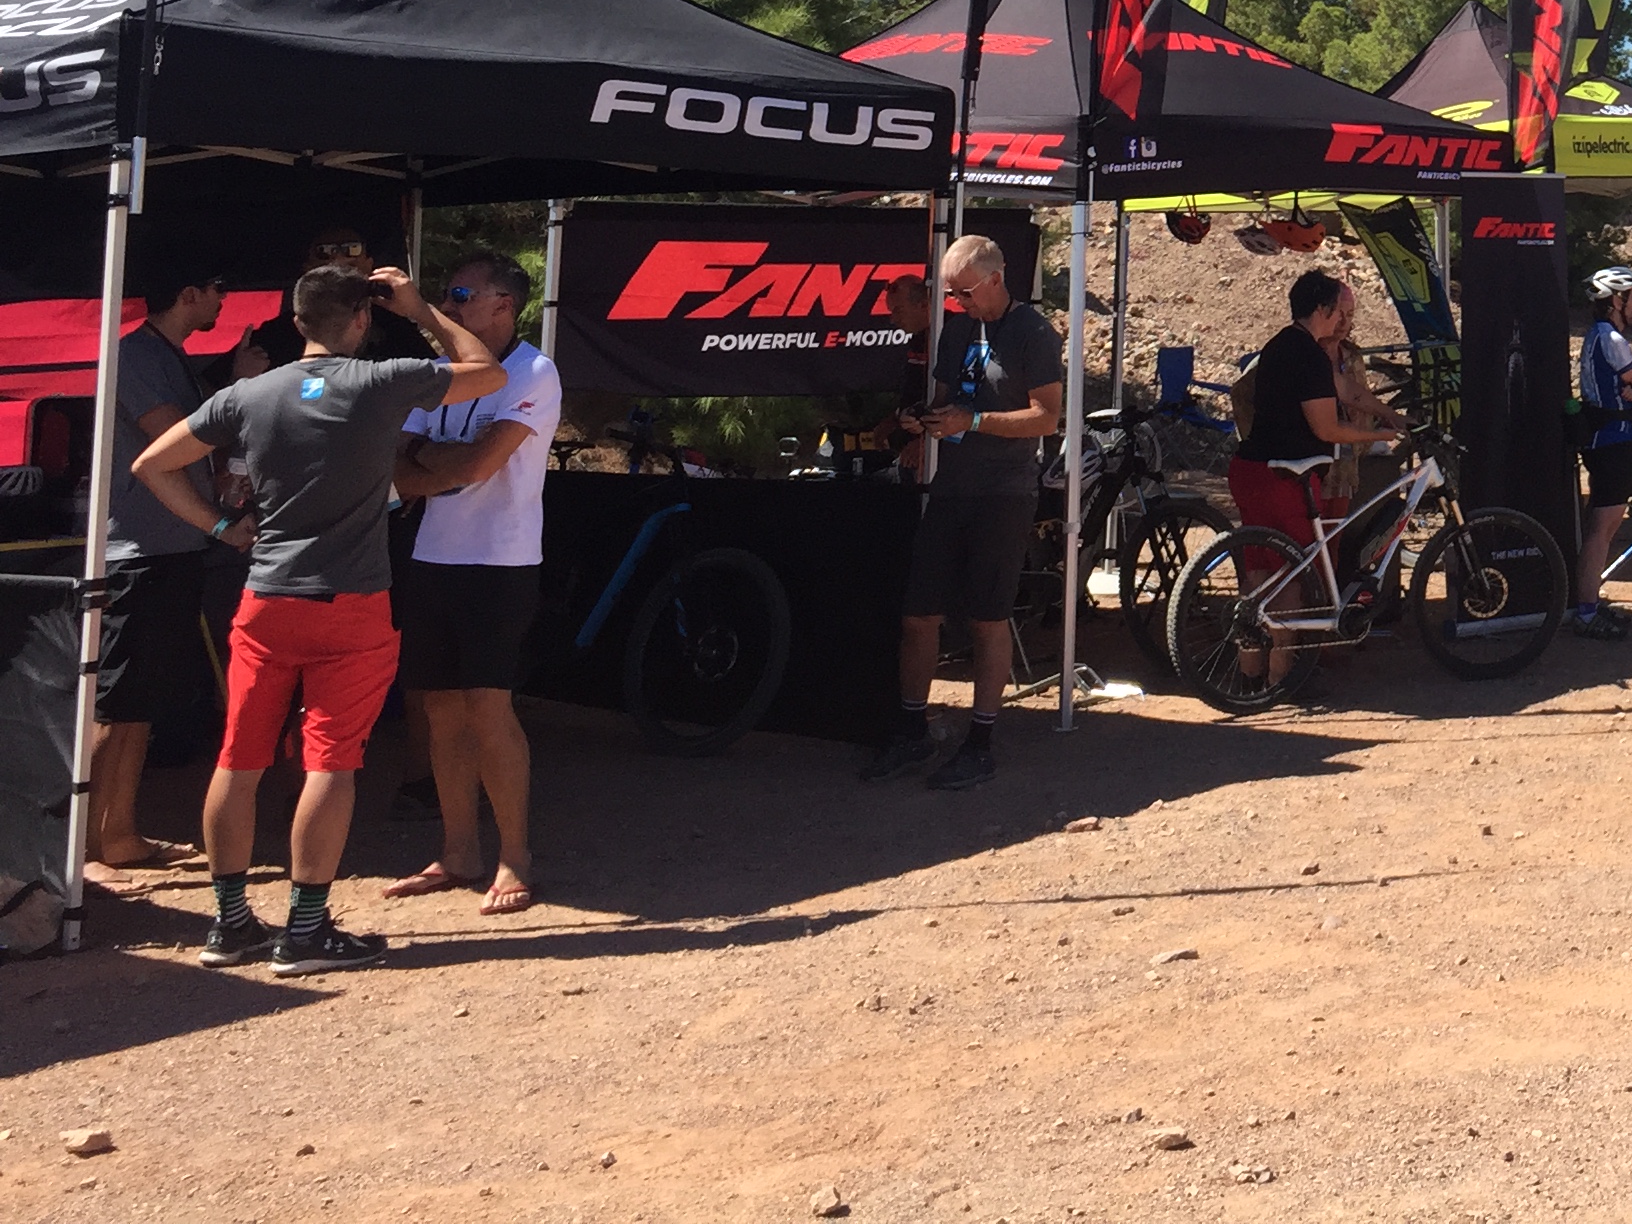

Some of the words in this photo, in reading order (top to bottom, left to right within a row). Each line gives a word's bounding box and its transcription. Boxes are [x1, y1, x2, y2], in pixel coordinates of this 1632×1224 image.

[590, 79, 937, 151] FOCUS
[1323, 122, 1503, 170] FANTIC
[1101, 159, 1184, 175] @fanticbicycles
[1473, 216, 1556, 238] FANTIC
[607, 240, 967, 321] FANT
[701, 332, 820, 352] POWERFUL
